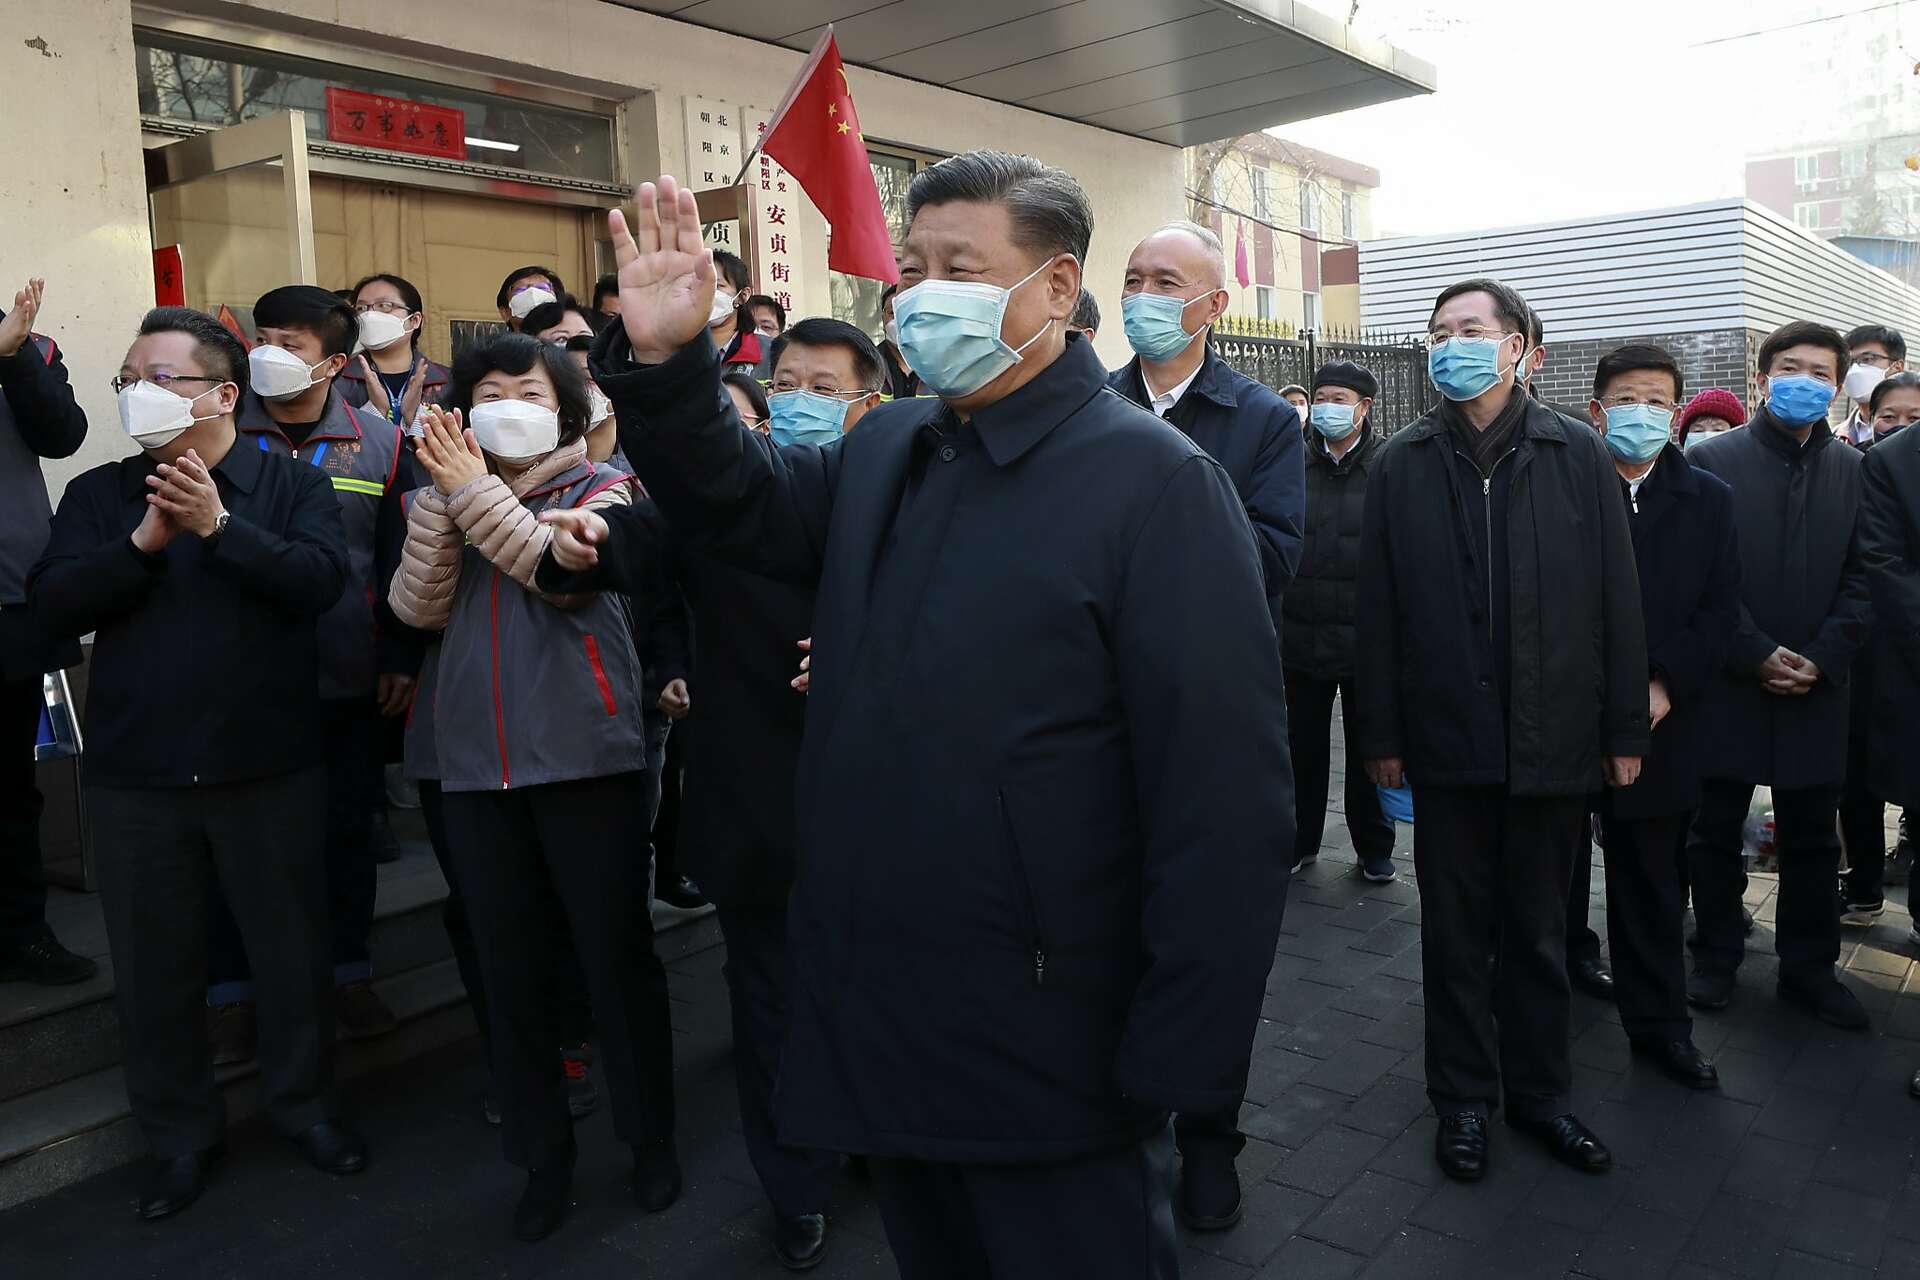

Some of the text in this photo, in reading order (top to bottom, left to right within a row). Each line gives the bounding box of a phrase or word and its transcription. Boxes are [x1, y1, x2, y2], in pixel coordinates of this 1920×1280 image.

[345, 110, 450, 148] 万事如意
[700, 111, 714, 183] 朝阳区
[717, 114, 731, 185] 北京市
